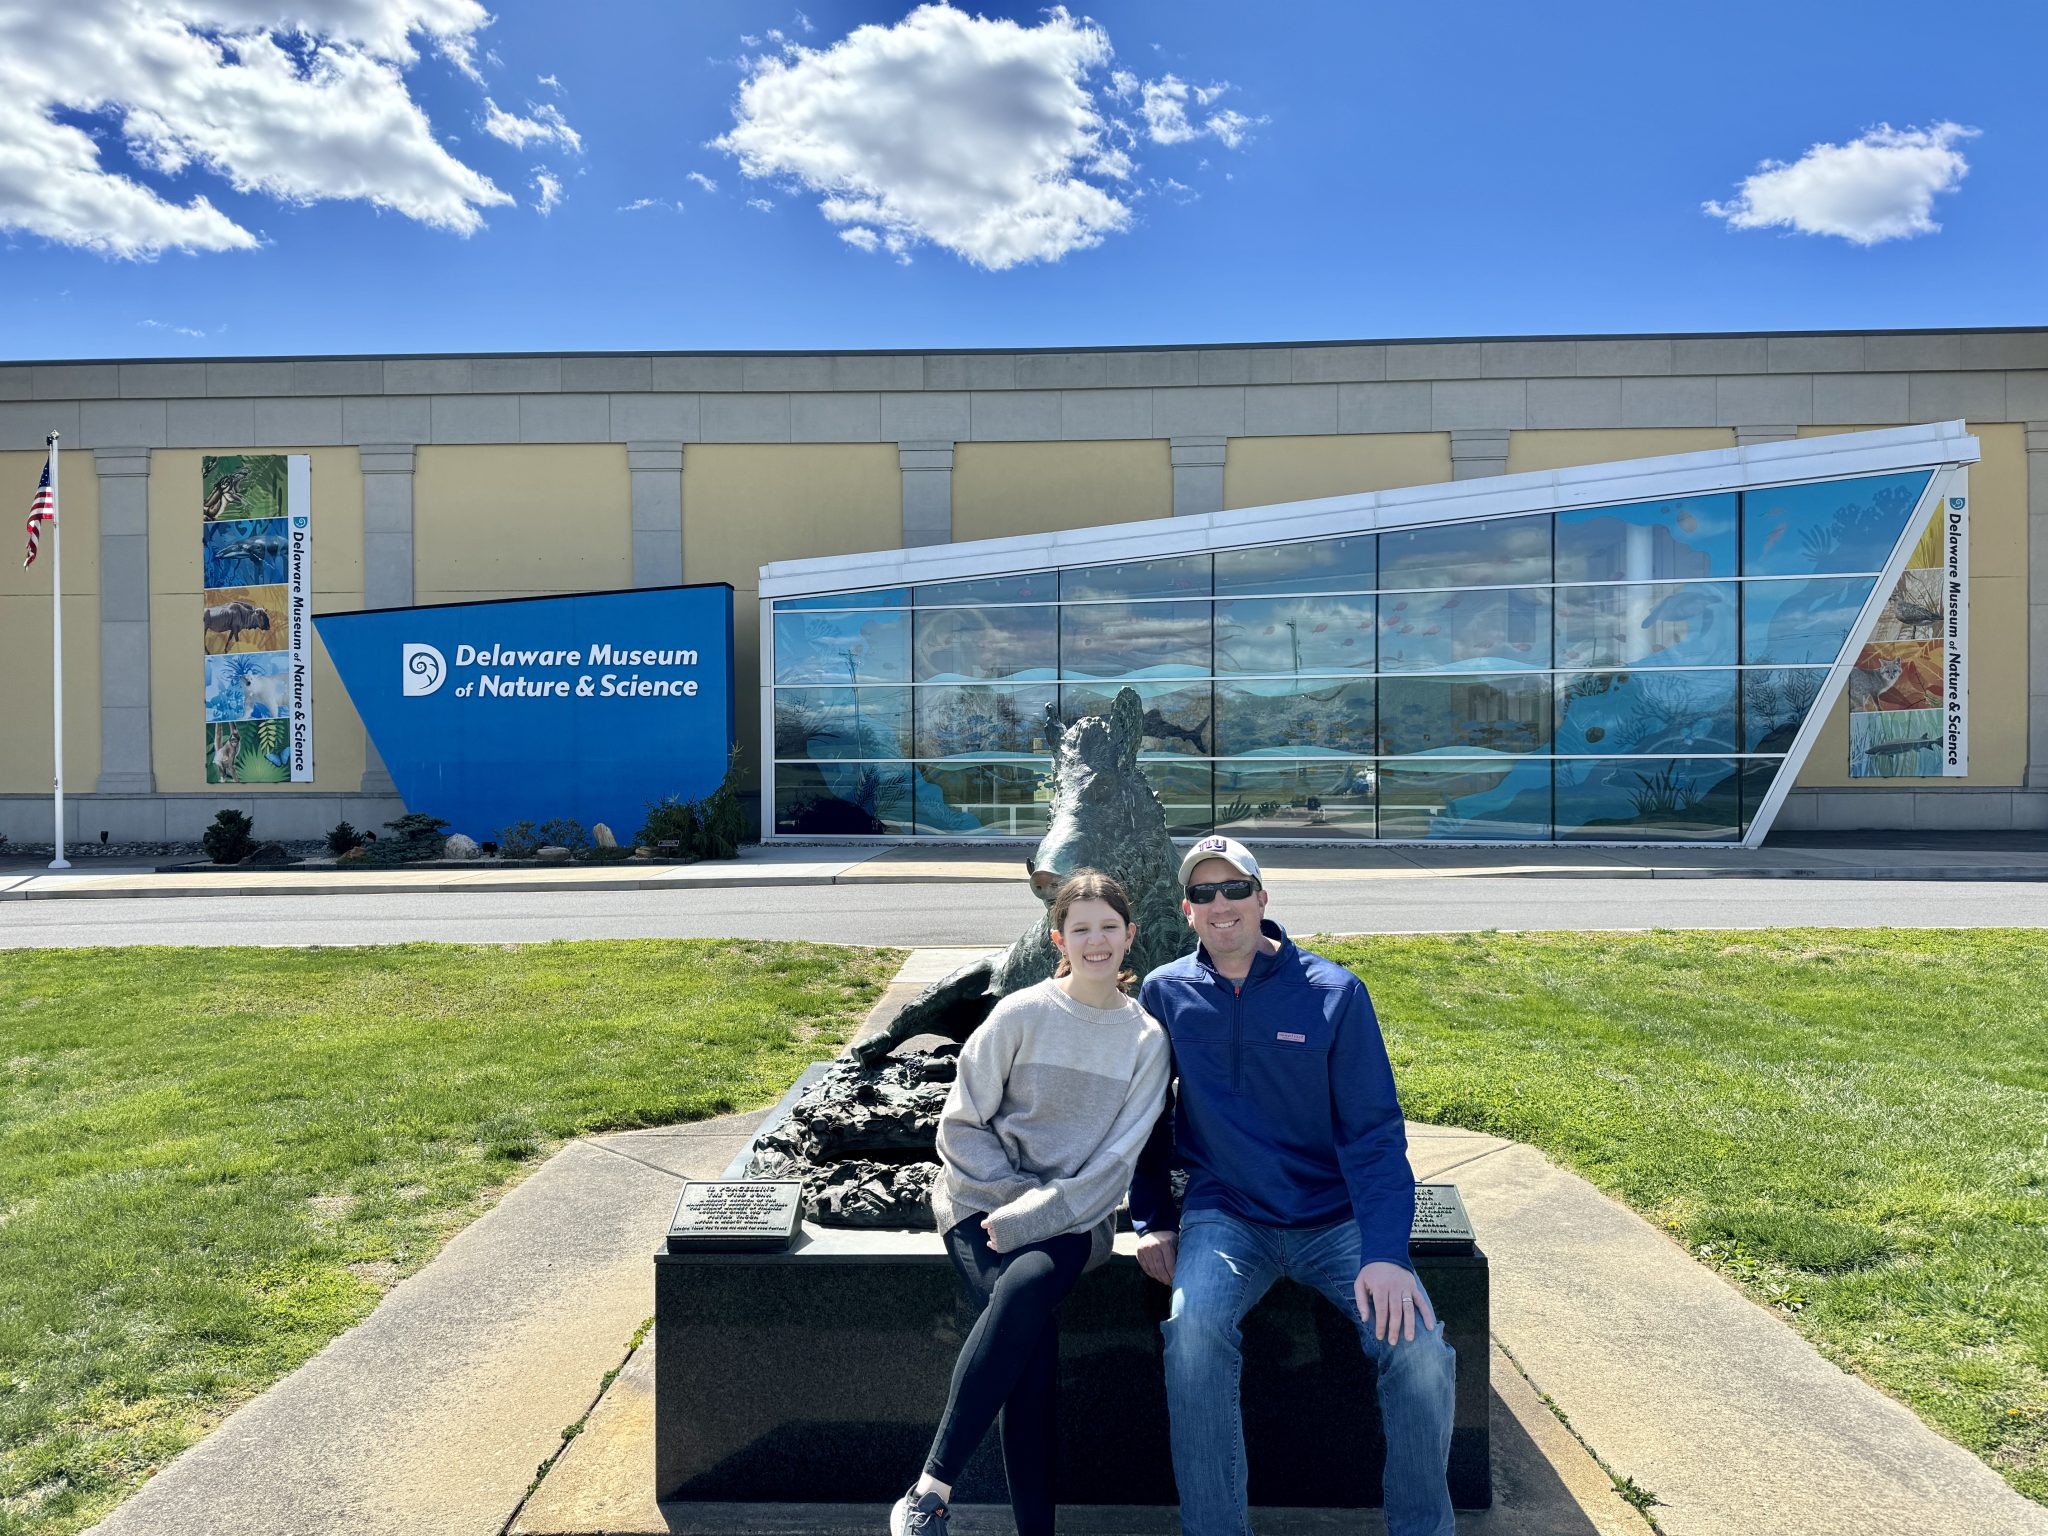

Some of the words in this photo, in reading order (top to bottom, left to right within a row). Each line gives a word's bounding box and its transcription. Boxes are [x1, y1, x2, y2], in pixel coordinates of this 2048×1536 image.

[292, 531, 305, 593] Delaware
[1949, 513, 1962, 578] Delaware
[293, 596, 305, 650] Museum
[1949, 581, 1961, 638] Museum
[293, 652, 302, 662] of
[455, 643, 581, 667] Delaware
[587, 643, 698, 666] Museum
[1949, 640, 1958, 650] of
[294, 664, 305, 709] Nature
[455, 682, 474, 698] of
[478, 674, 570, 698] Nature
[575, 674, 595, 697] &
[599, 673, 699, 698] Science
[1948, 652, 1961, 700] Nature
[294, 711, 305, 721] &
[1948, 701, 1961, 712] &
[294, 723, 306, 772] Science
[1948, 714, 1961, 765] Science
